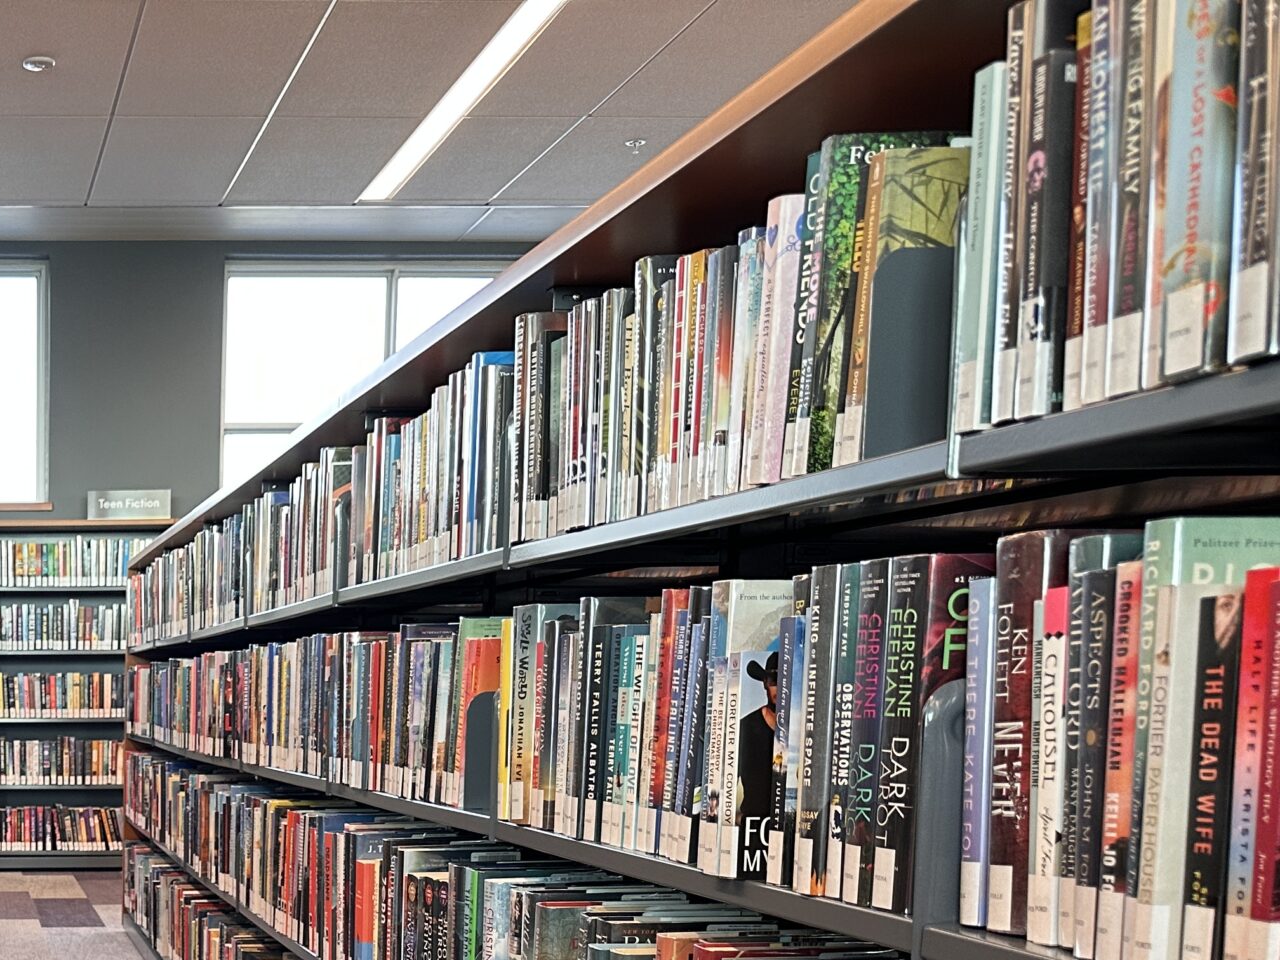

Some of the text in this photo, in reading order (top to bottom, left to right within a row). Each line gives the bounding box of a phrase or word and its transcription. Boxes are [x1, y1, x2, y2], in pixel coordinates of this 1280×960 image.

[1033, 63, 1045, 143] RUDOLPH FISHER
[1125, 102, 1142, 194] FAMILY
[1183, 86, 1205, 275] LOST CATHEDRAL
[795, 239, 813, 345] FRIENDS
[806, 252, 820, 323] MOVE
[860, 265, 870, 312] SWALLOW
[98, 498, 160, 509] Teen Fiction
[1193, 538, 1240, 548] Pulitzer
[517, 613, 532, 700] SMALL WORLD
[862, 612, 882, 719] CHRISTINE
[884, 607, 903, 718] FEEHAN
[896, 607, 918, 718] CHRISTINE
[995, 602, 1014, 704] FOLLETT
[1011, 627, 1029, 675] KEN
[1137, 540, 1161, 730] RICHARD FORD
[590, 692, 600, 736] FALLIS
[630, 673, 644, 729] WEIGHT
[803, 604, 820, 788] KING INFINITE SPACE
[838, 683, 853, 787] OBSERVATIONS
[965, 658, 980, 736] THERE
[1043, 653, 1060, 790] CAROUSEL
[1082, 591, 1104, 819] ASPECTS JOHN
[1103, 579, 1133, 865] CROOKED HALLELUJAH KELLI JO
[724, 693, 738, 824] FOREVER COWBOY
[855, 743, 875, 823] DARK
[875, 745, 892, 847] TAROT
[887, 736, 910, 820] DARK
[992, 720, 1024, 819] NEVER
[1145, 675, 1168, 830] FORTIER PAPER
[1193, 664, 1226, 855] THE DEAD WIFE
[1238, 640, 1264, 865] HALF LIFE KRISTA
[1263, 707, 1278, 790] SEPTOLOGY
